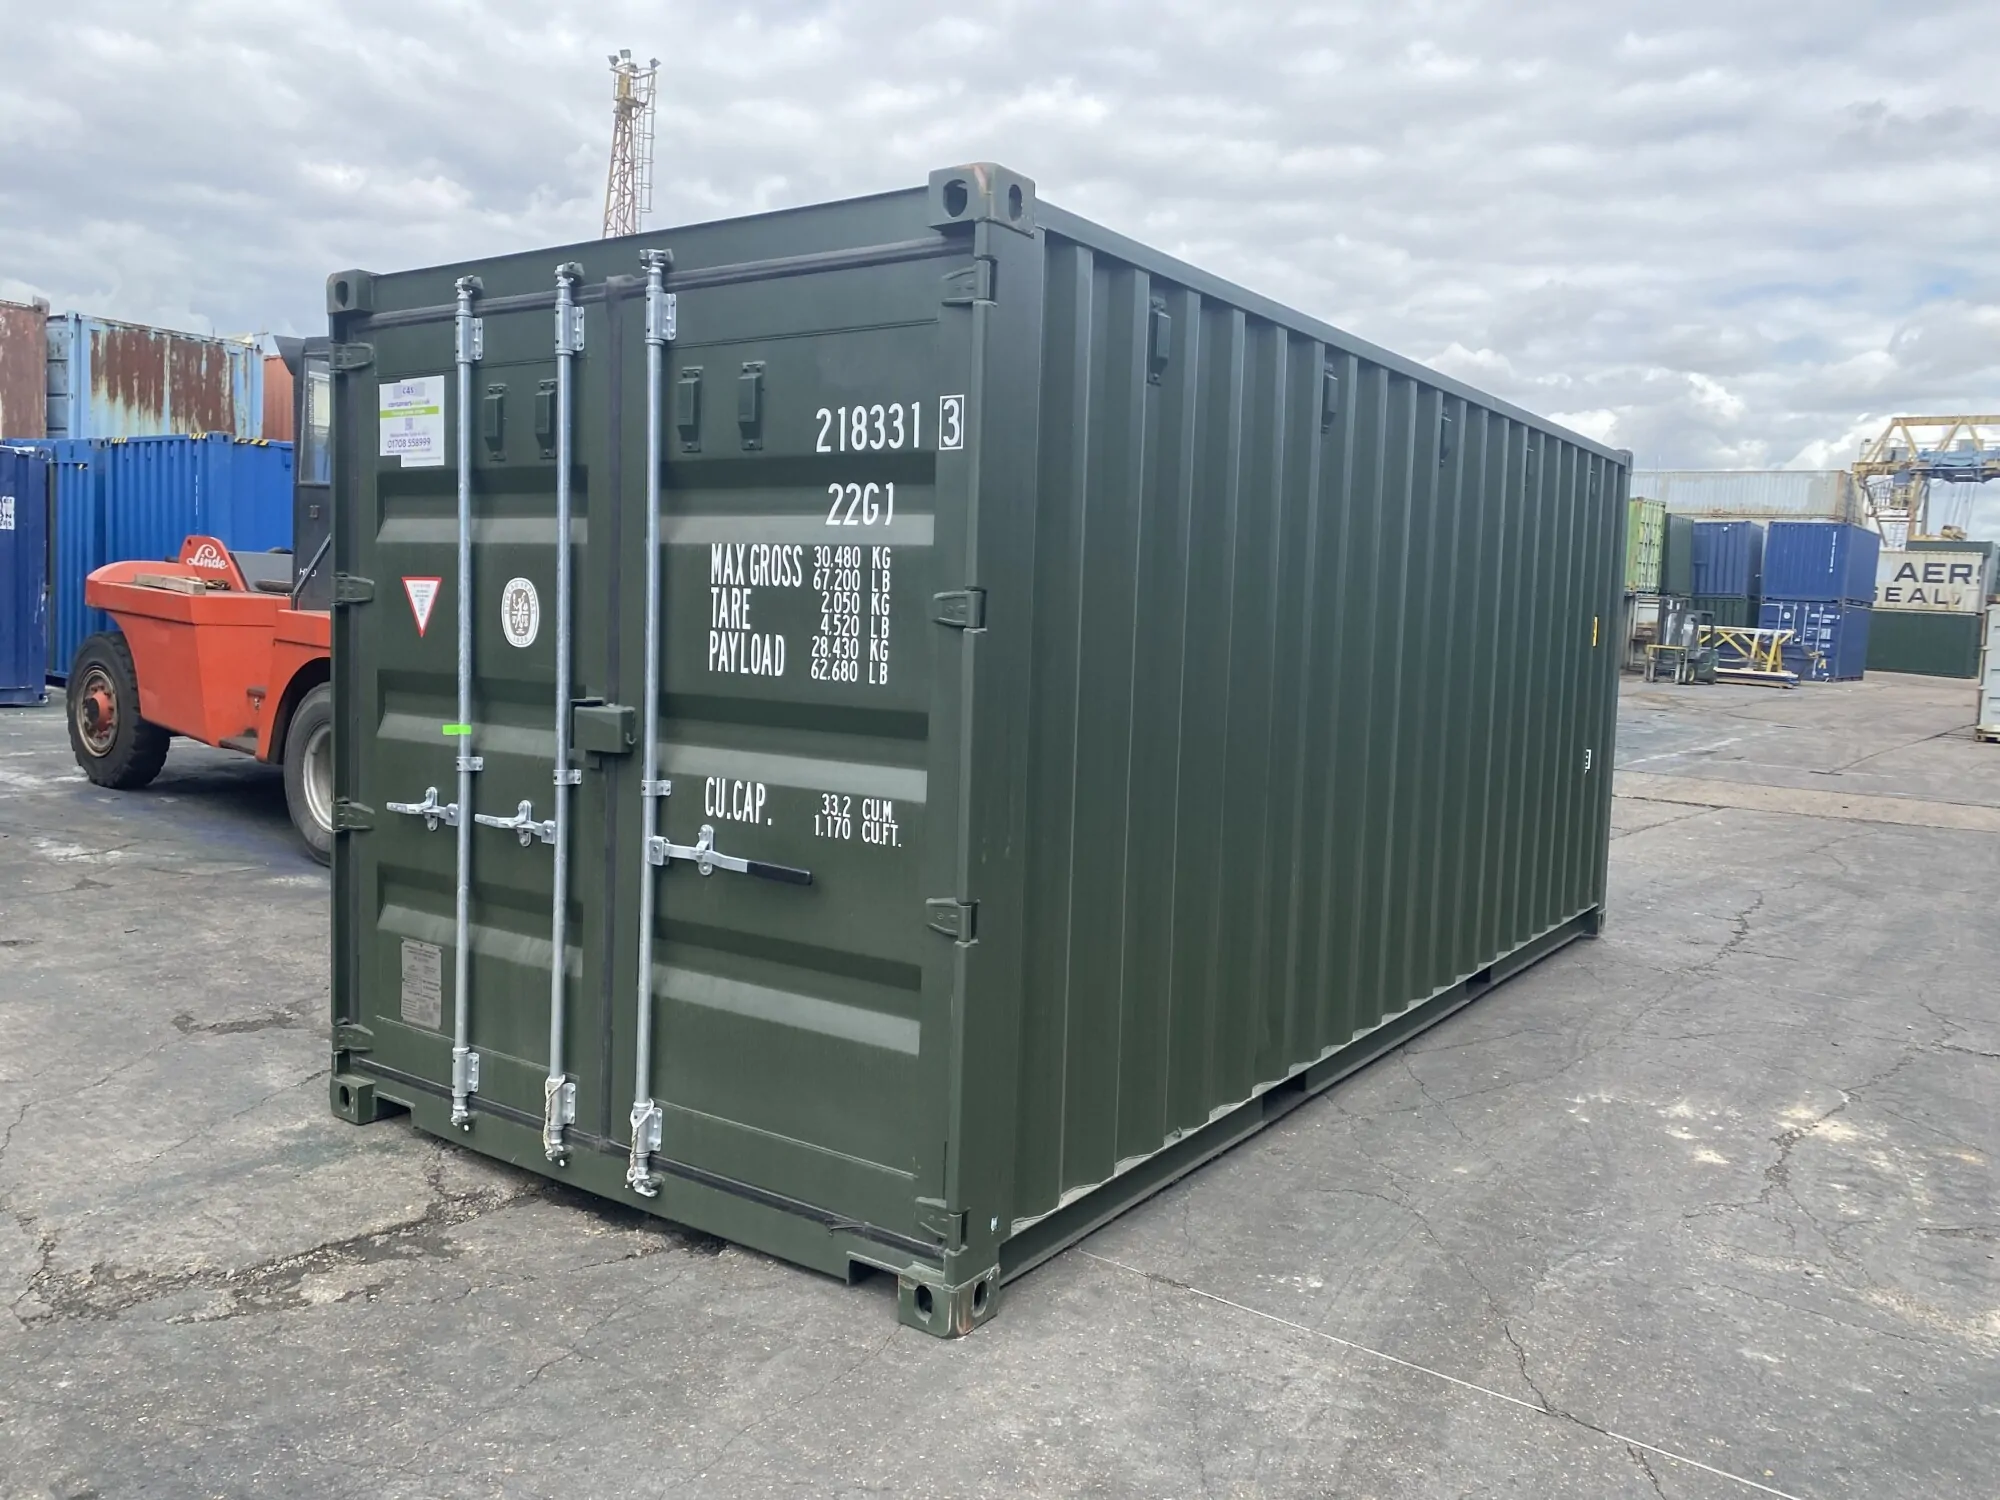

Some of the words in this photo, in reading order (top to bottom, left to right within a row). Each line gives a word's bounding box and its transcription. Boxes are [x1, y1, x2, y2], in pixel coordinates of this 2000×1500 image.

[387, 438, 407, 449] 01708
[816, 401, 920, 453] 218331
[942, 399, 960, 446] 3
[825, 482, 894, 526] 22G1
[186, 543, 229, 570] Linde
[710, 542, 746, 586] MAX
[749, 543, 803, 588] GROSS
[813, 545, 861, 569] 30.480
[872, 546, 891, 570] KG
[813, 568, 861, 592] 67.200
[871, 569, 891, 593] LB
[710, 586, 752, 630] TARE
[821, 590, 860, 615] 2.050
[871, 592, 890, 616] KG
[820, 613, 860, 637] 4.520
[870, 615, 890, 639] LB
[709, 630, 785, 677] PAYLOAD
[811, 635, 859, 660] 28.430
[869, 638, 889, 662] KG
[810, 658, 858, 683] 62.680
[868, 661, 888, 685] LB
[705, 776, 772, 826] CU.CAP.
[821, 793, 850, 817] 33.2
[862, 798, 895, 823] CU.M.
[814, 814, 850, 840] 1.170
[861, 820, 902, 848] CU.FT.
